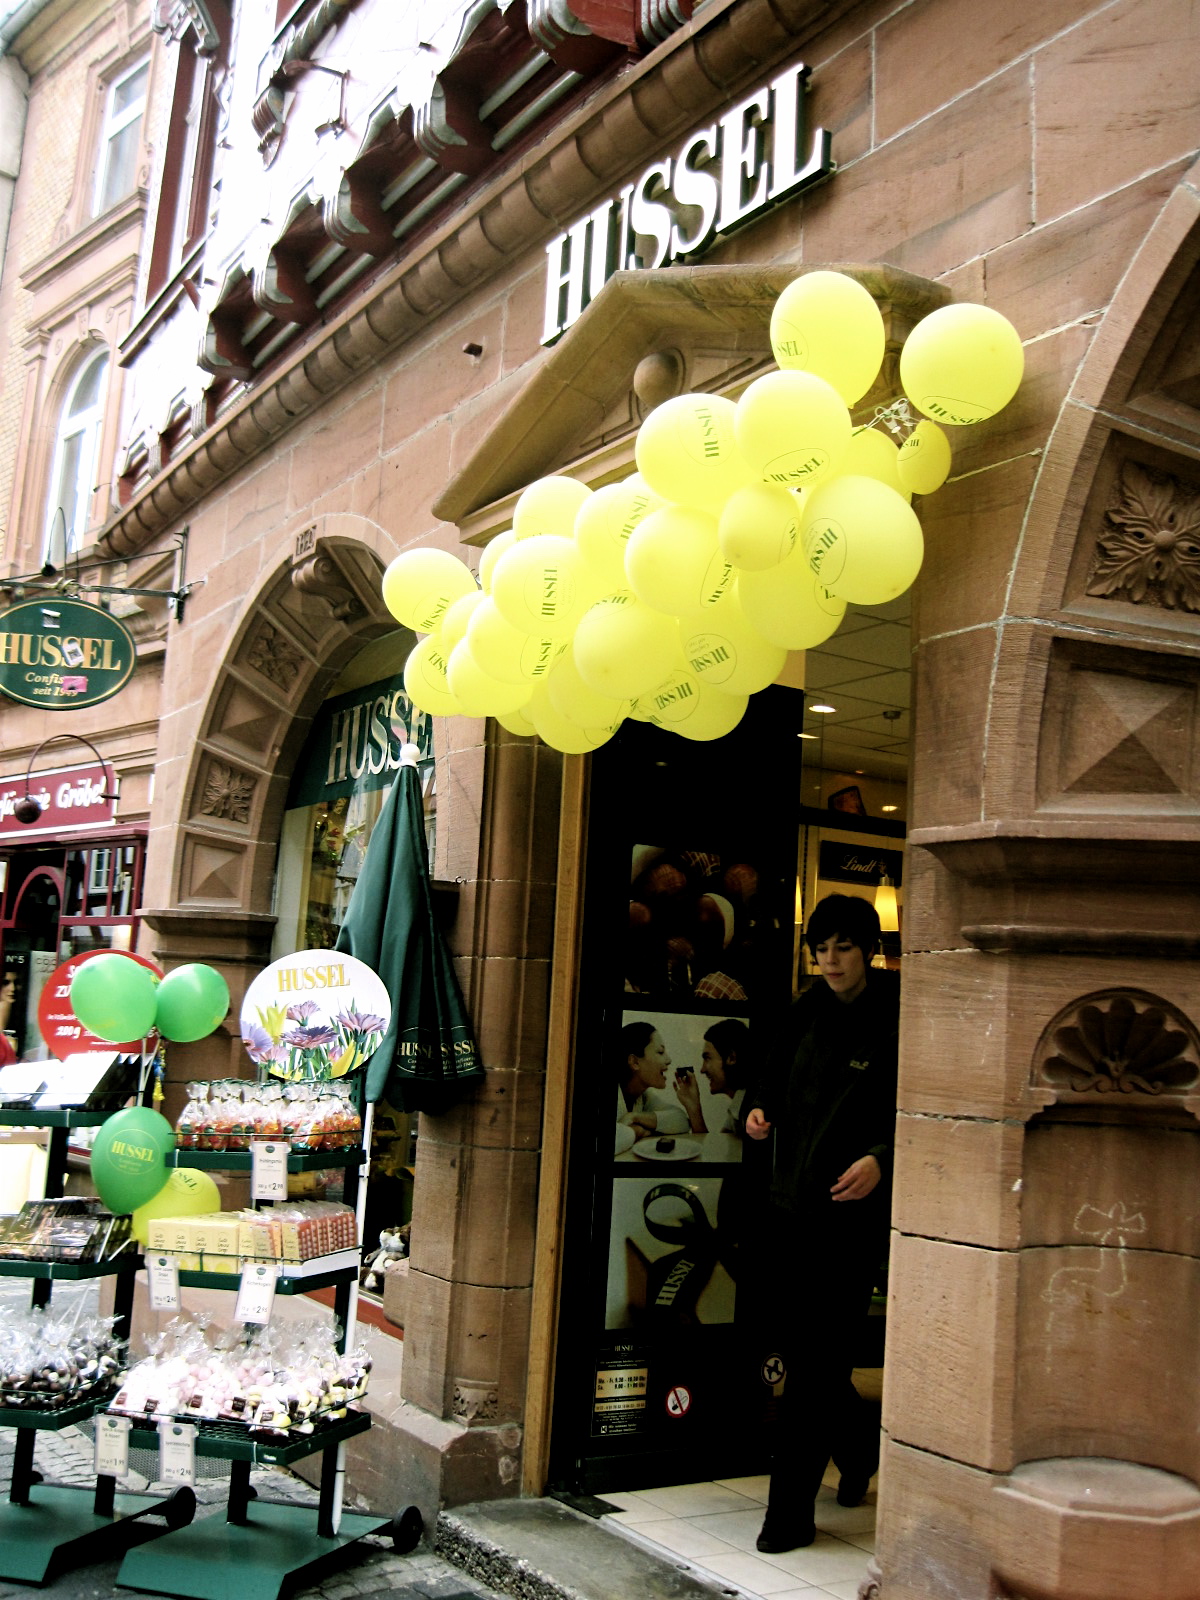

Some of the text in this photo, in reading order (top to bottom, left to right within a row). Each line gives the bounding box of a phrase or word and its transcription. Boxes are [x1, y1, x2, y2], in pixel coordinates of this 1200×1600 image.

[540, 62, 826, 347] HUSSEL
[776, 341, 803, 357] SSEL
[770, 457, 824, 482] HUSSEL
[541, 566, 558, 616] HUSSEL
[708, 559, 733, 603] HUSSE
[428, 651, 448, 677] SSEL
[531, 638, 553, 675] HUSSE
[33, 687, 52, 696] seit
[325, 689, 433, 785] HUSSE
[840, 854, 878, 873] Lindt
[277, 963, 351, 993] HUSSEL
[111, 1140, 155, 1163] HUSSEL
